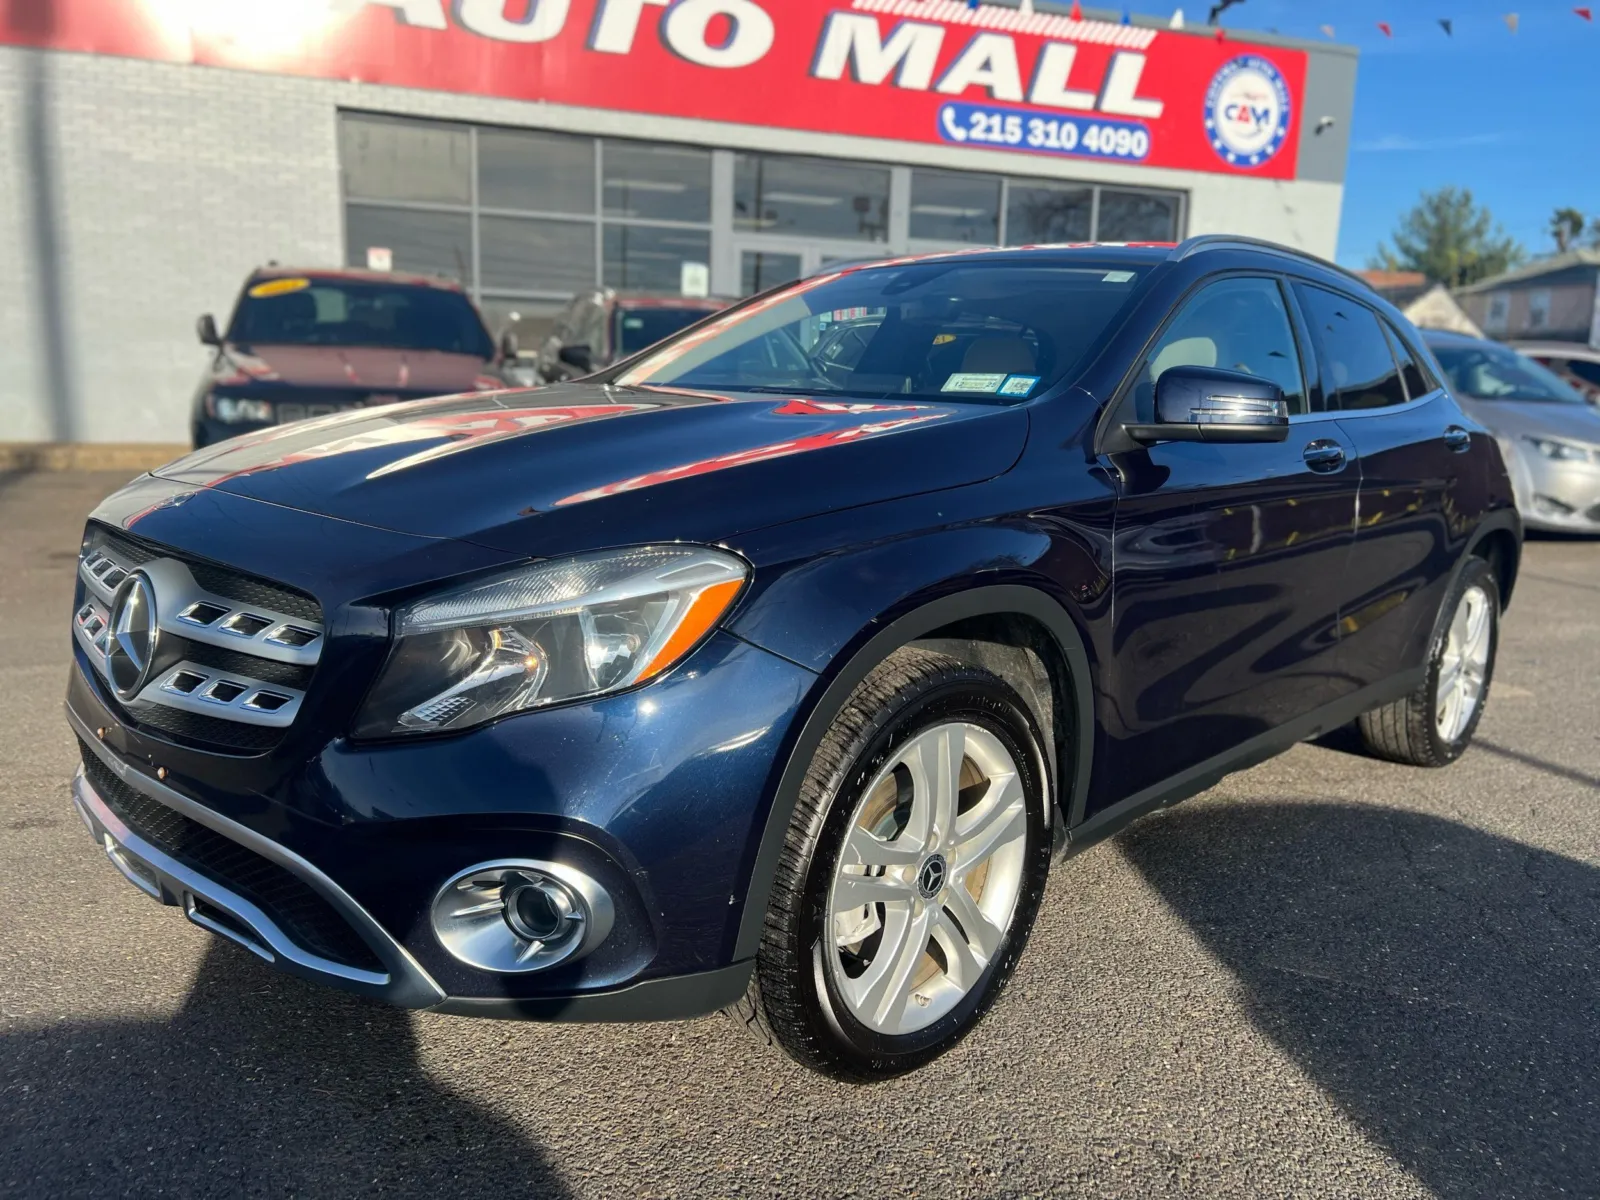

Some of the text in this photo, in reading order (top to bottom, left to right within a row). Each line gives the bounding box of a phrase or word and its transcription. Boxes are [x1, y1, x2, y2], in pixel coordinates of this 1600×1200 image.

[811, 10, 1165, 119] MALL
[969, 112, 1149, 158] 215 310 4090
